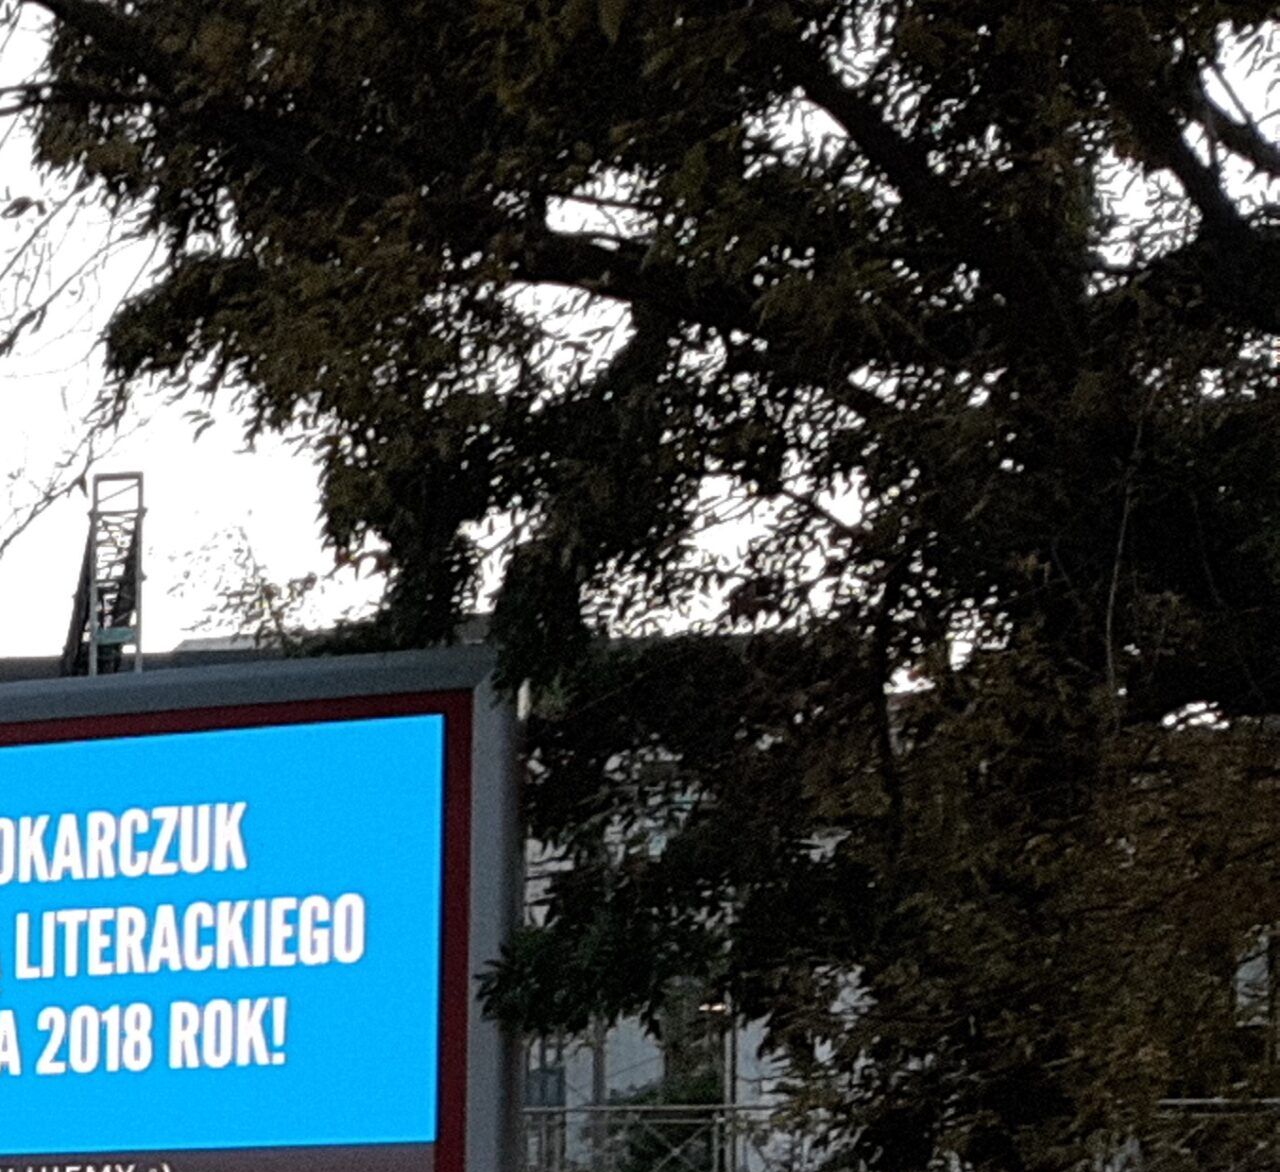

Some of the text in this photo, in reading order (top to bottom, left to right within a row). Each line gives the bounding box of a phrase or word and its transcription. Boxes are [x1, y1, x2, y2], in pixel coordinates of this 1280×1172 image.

[16, 893, 365, 979] LITERACKIEGO
[36, 1003, 154, 1075] 2018
[170, 997, 287, 1069] ROK!
